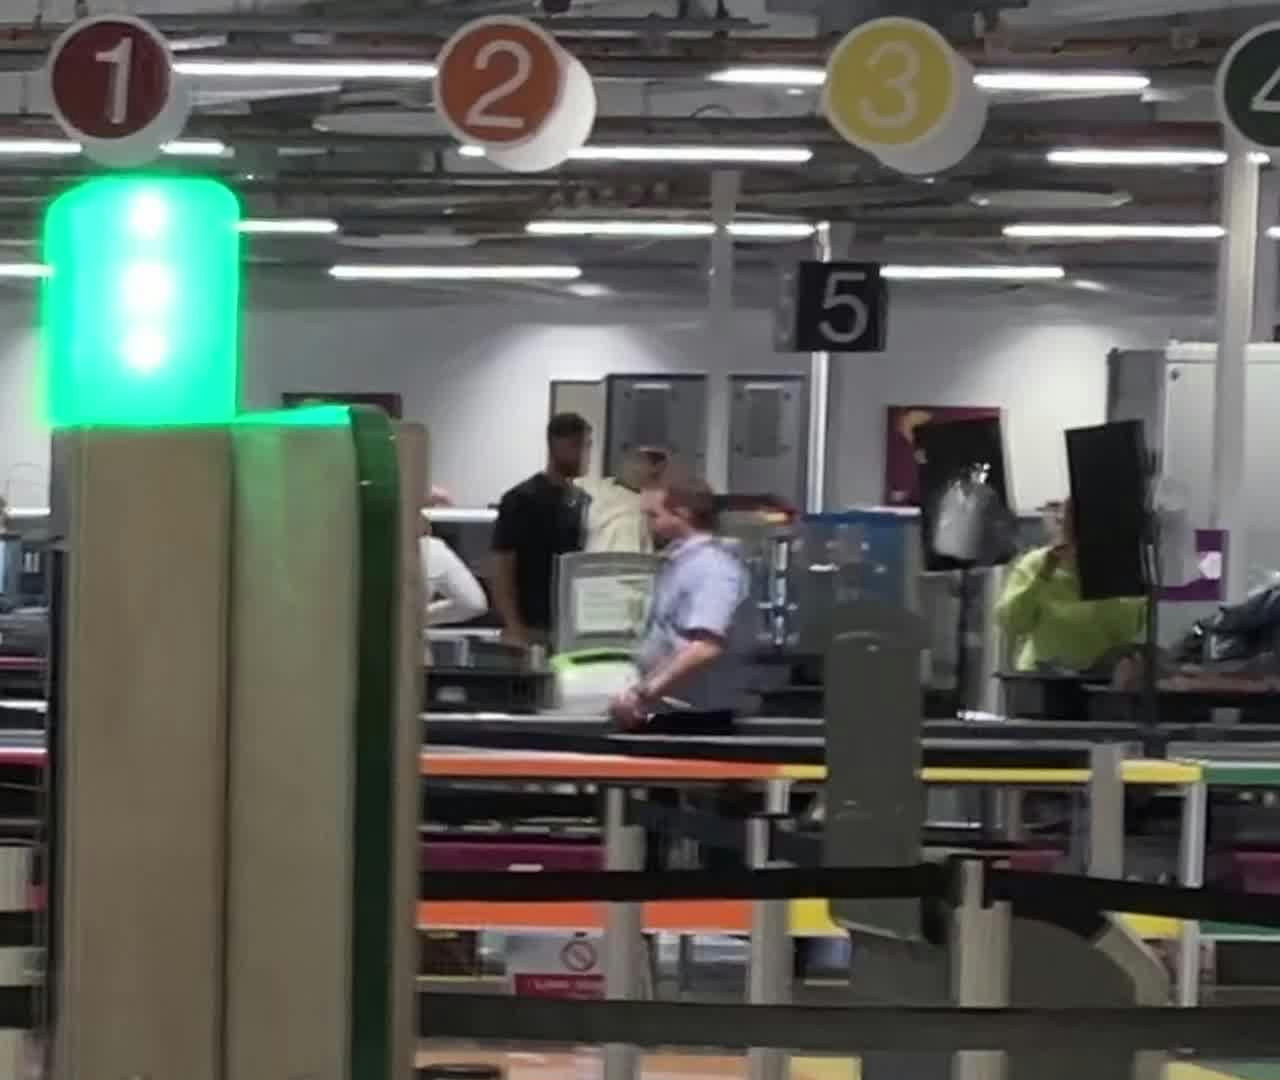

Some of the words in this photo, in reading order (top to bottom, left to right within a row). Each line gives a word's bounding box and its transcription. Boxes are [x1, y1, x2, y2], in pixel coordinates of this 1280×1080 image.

[95, 37, 133, 124] 1
[464, 40, 531, 128] 2
[858, 39, 920, 129] 3
[819, 271, 869, 343] 5
